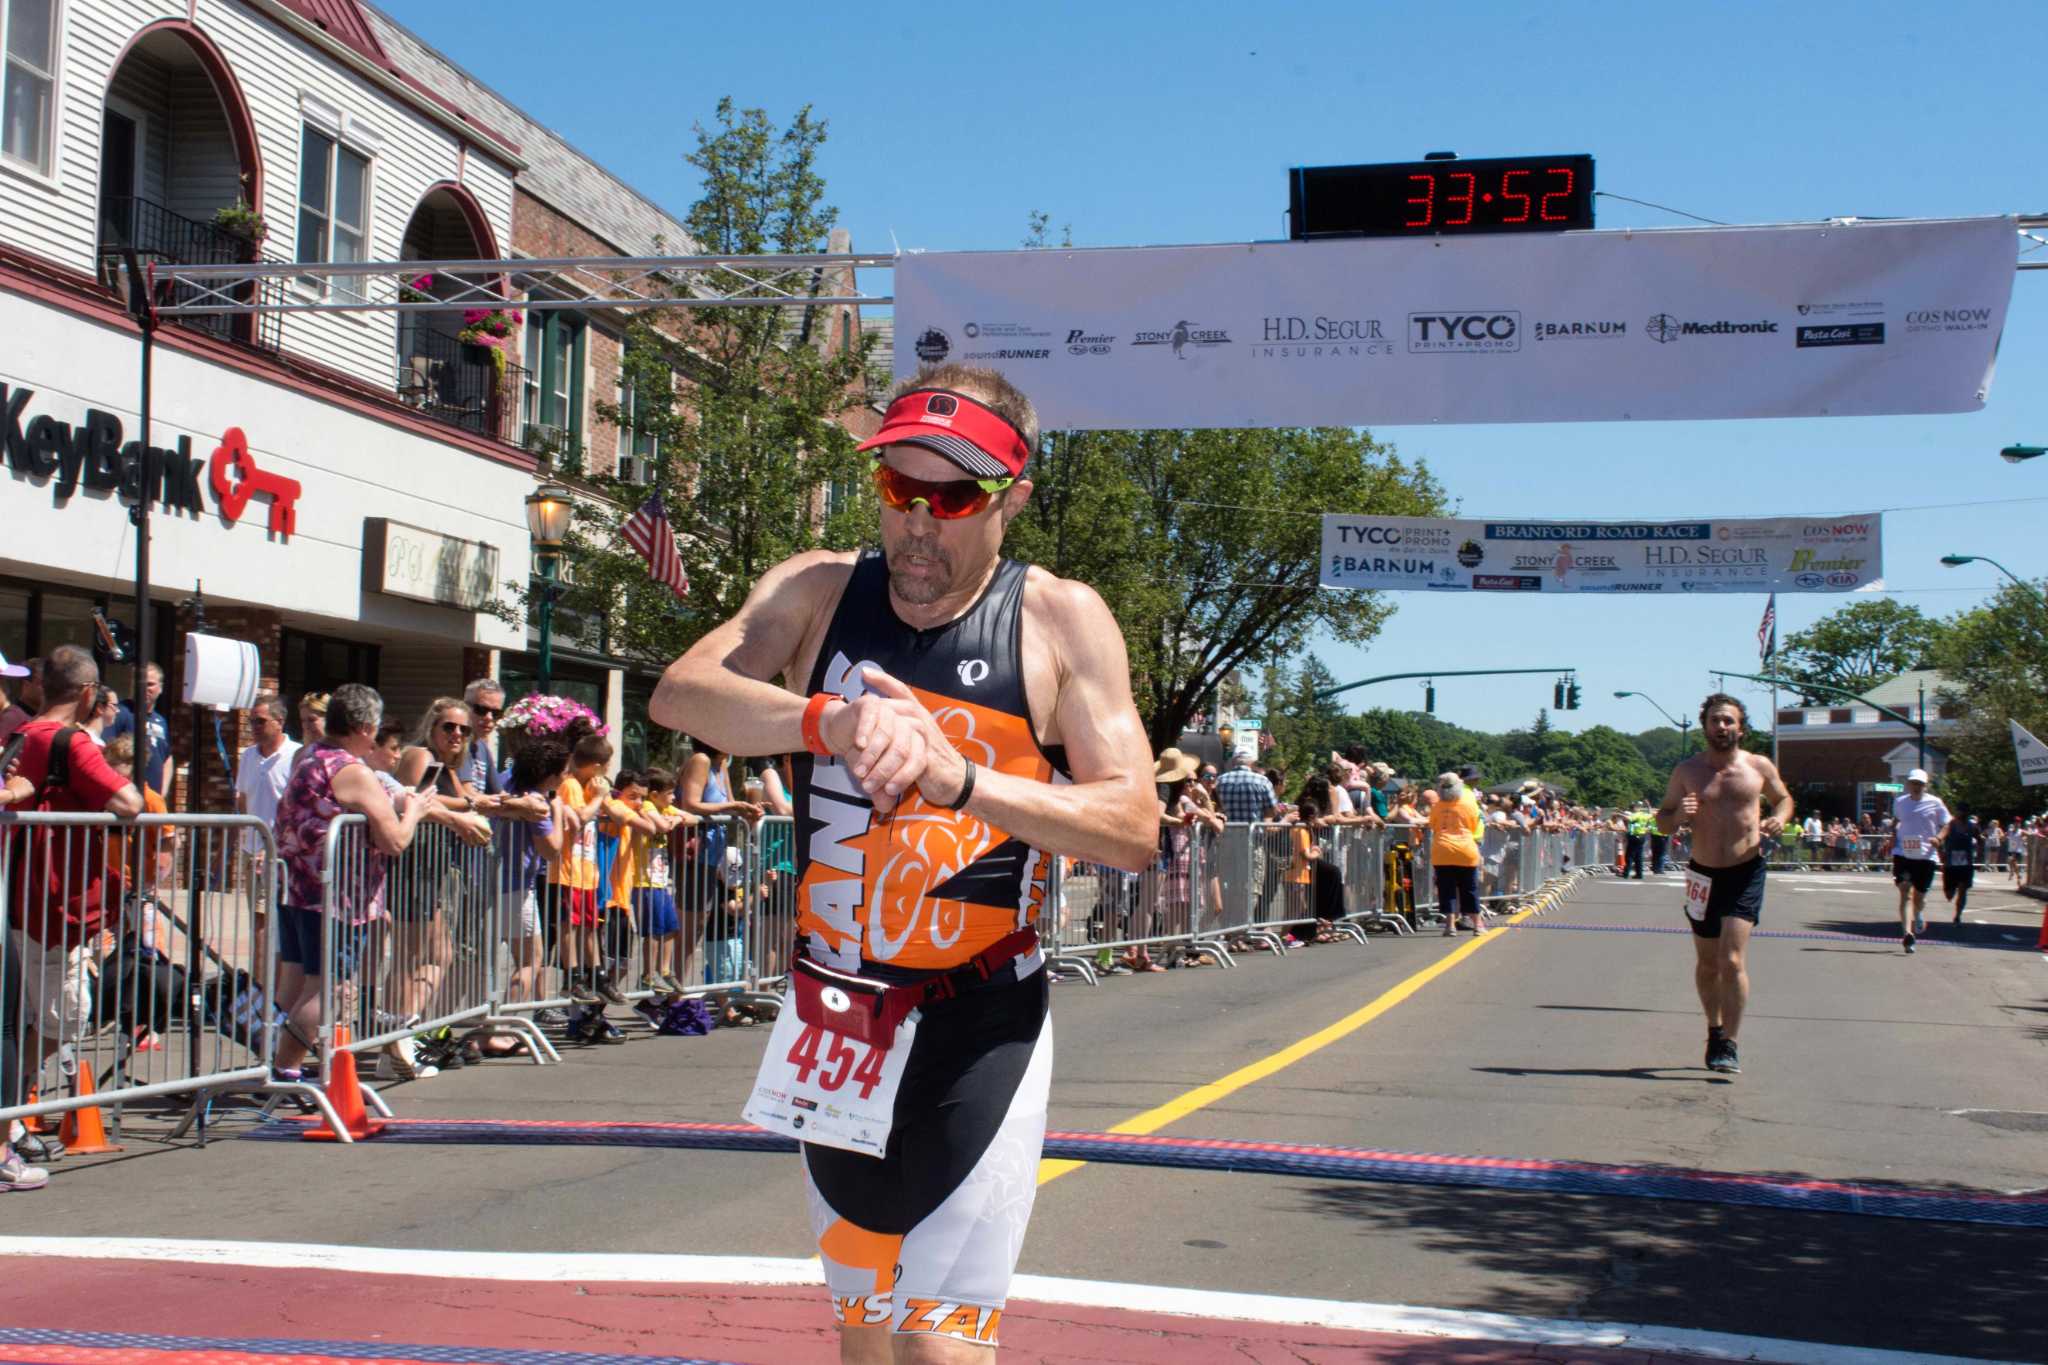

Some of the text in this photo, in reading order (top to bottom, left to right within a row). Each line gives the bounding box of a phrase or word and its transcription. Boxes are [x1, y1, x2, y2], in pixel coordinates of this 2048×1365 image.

[1263, 316, 1384, 342] H.D. SEGUR
[1413, 315, 1516, 341] TYCO
[1545, 321, 1627, 336] BARNUM
[1681, 320, 1779, 335] Medtronic
[1065, 329, 1116, 344] Premier
[1135, 330, 1227, 342] STONY CREEK
[1252, 344, 1395, 358] INSURANCE
[0, 380, 206, 513] KeyBank
[1337, 525, 1402, 545] TYCO
[1494, 525, 1699, 539] BRANFORD ROAD RACE
[1405, 537, 1451, 547] PROMO
[1514, 555, 1616, 567] STONY CREEK
[1645, 545, 1769, 566] H.D. SEGUR
[1344, 557, 1434, 574] BARNUM
[1645, 567, 1768, 578] INSURANCE
[786, 1022, 888, 1101] 454
